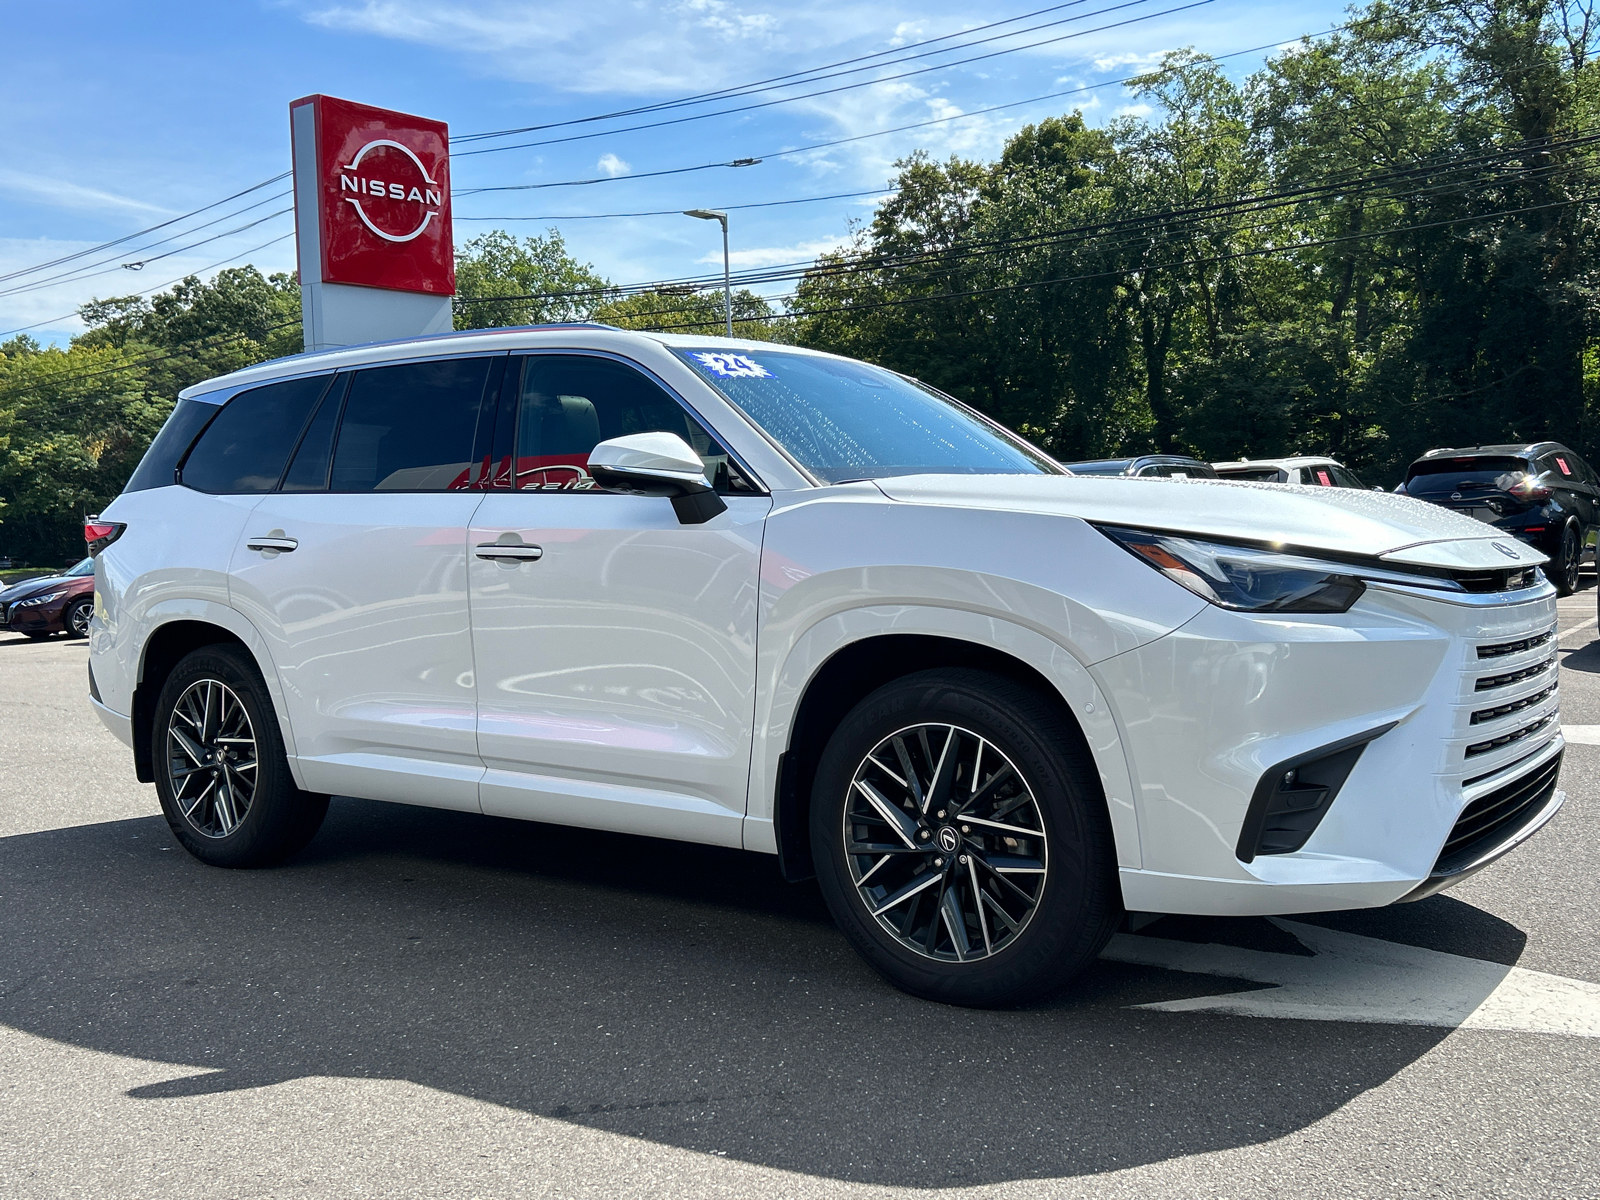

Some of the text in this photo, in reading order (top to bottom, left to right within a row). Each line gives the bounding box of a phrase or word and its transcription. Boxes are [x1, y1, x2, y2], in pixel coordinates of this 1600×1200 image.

[341, 174, 441, 206] NISSAN
[712, 357, 754, 371] 24
[1032, 756, 1055, 789] 107V
